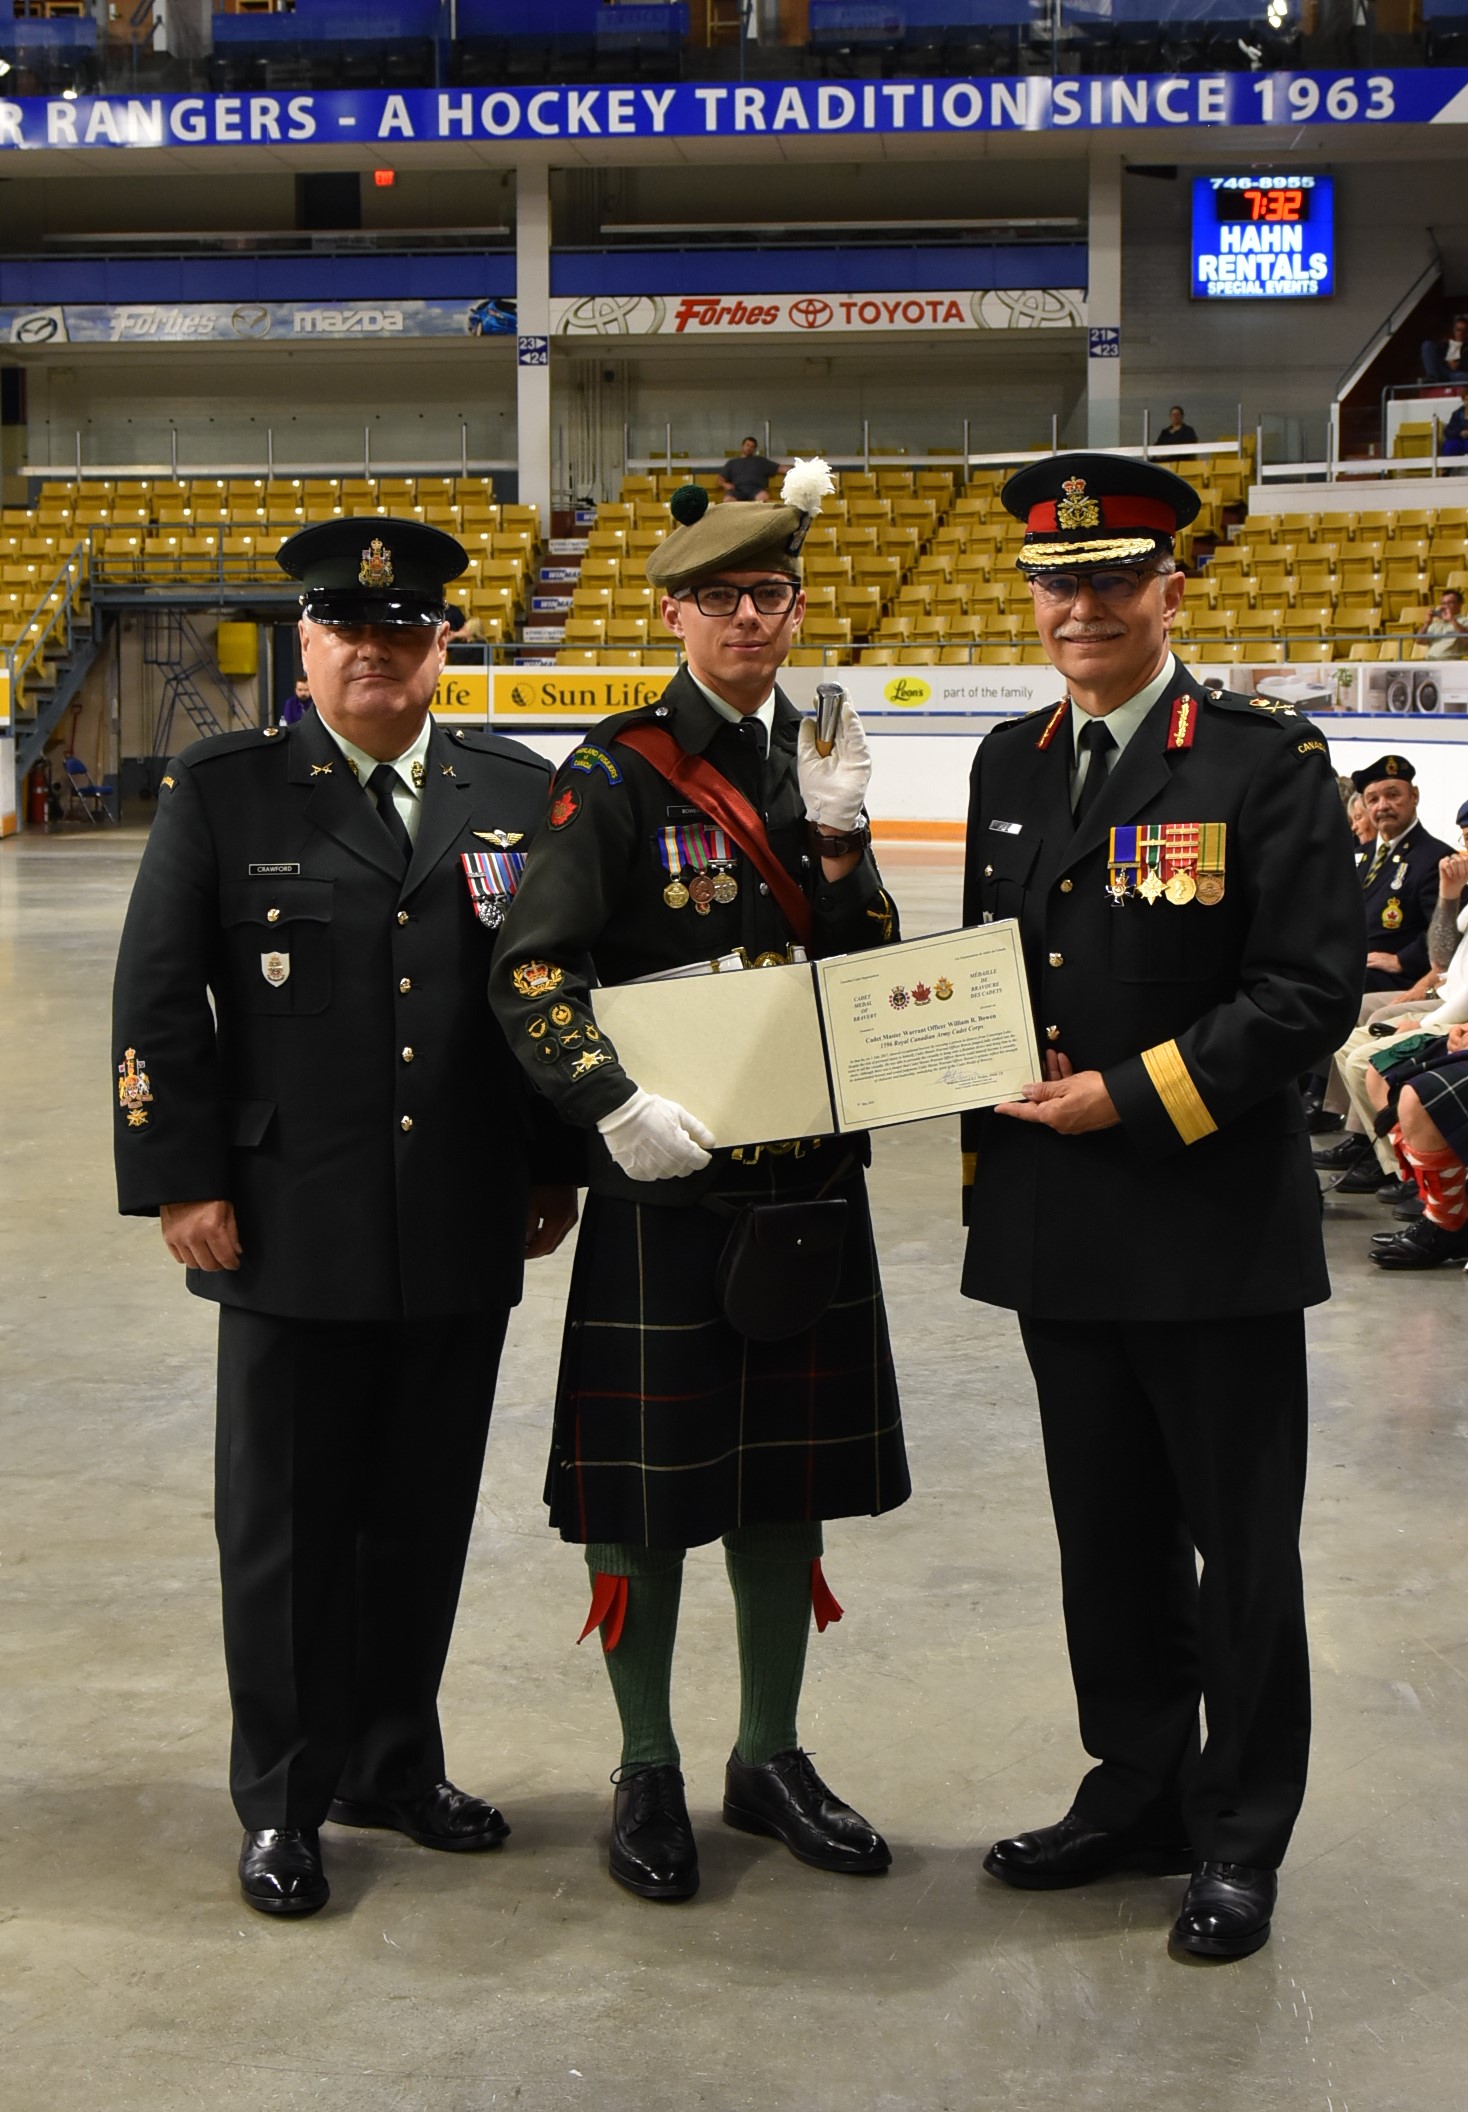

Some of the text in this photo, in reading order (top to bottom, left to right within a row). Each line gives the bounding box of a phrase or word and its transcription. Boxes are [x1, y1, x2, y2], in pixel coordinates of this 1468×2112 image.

[47, 96, 316, 144] RANGERS
[377, 95, 415, 138] A
[438, 89, 676, 136] HOCKEY
[695, 82, 1026, 131] TRADITION
[1053, 79, 1226, 125] SINCE
[1254, 76, 1395, 121] 1963
[1210, 176, 1315, 190] 746-8955
[1244, 191, 1302, 221] 7:32
[1220, 225, 1302, 253] HAHN
[1199, 253, 1328, 282] RENTALS
[1207, 280, 1319, 295] SPECIAL EVENTS
[674, 298, 780, 333] Forbes
[839, 300, 965, 324] TOYOTA
[109, 305, 216, 342] Forbes
[1090, 329, 1106, 341] 21
[519, 337, 535, 350] 23
[1102, 343, 1119, 356] 23
[531, 351, 547, 364] 24
[541, 682, 658, 706] Sun Life
[944, 686, 1034, 700] part of the family
[257, 865, 292, 873] CRAWFORD
[853, 994, 871, 1003] CADET
[981, 988, 1003, 997] CADETS
[854, 1001, 873, 1009] MEDAL
[853, 1013, 877, 1022] BRAVERY
[865, 1036, 882, 1044] Cadet
[882, 1032, 902, 1040] Master
[902, 1027, 927, 1036] Warrant
[926, 1024, 947, 1032] Officer
[978, 1014, 997, 1022] Bowen
[893, 1039, 909, 1047] Royal
[909, 1034, 936, 1043] Canadian
[936, 1030, 951, 1039] Army
[968, 1025, 984, 1033] Corps
